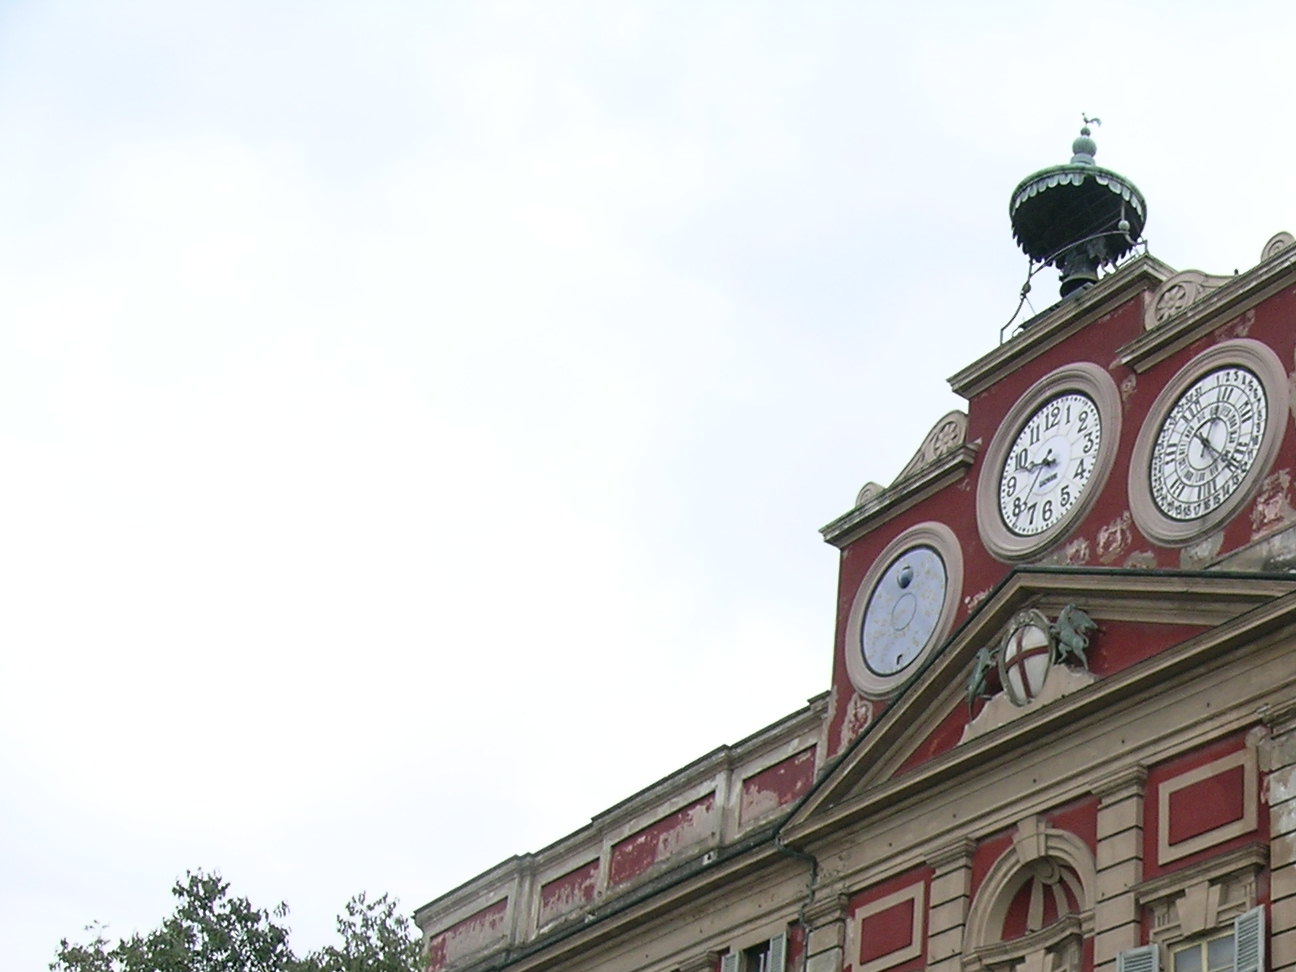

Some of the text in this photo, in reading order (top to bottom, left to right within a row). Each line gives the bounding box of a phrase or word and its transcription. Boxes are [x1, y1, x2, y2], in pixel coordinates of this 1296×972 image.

[1045, 407, 1060, 432] 12
[1065, 405, 1071, 424] 1
[1078, 411, 1088, 433] 2
[1030, 424, 1040, 446] 11
[1083, 431, 1094, 453] 3
[1014, 448, 1028, 471] 10
[1073, 458, 1086, 480] 4
[1006, 476, 1017, 497] 9
[1060, 485, 1070, 507] 5
[1012, 497, 1021, 517] 8
[1027, 502, 1038, 525] 7
[1042, 500, 1053, 522] 6
